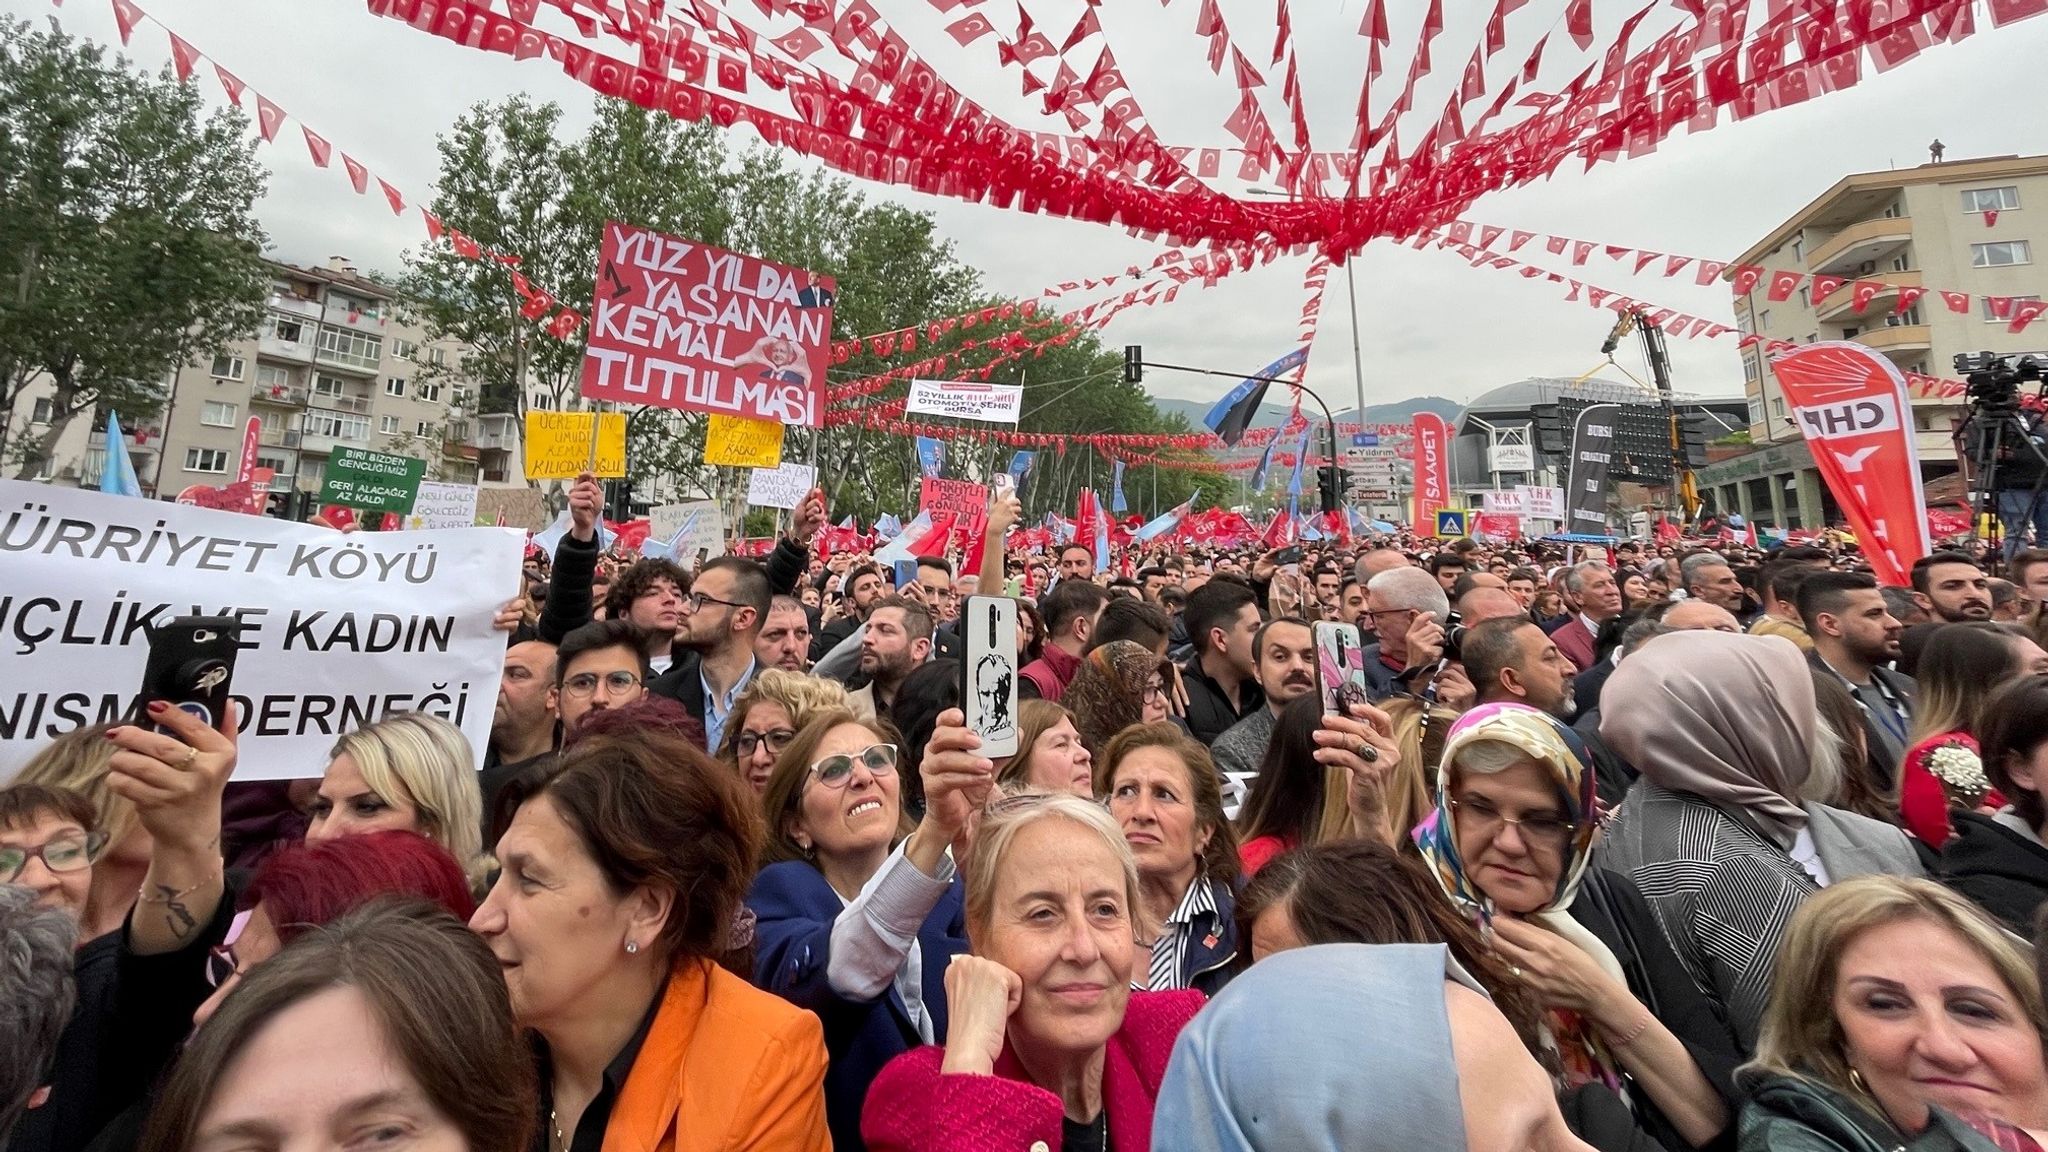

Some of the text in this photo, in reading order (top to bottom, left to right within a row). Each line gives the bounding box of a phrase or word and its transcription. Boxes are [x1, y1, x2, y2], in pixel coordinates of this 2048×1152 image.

[612, 225, 802, 307] YÜZ YILDA
[595, 298, 736, 368] KEMAL
[643, 270, 824, 347] YAŞANAN
[586, 346, 815, 426] TUTULMASI
[1359, 449, 1394, 457] Yıldırım
[1422, 427, 1441, 499] SAADET
[336, 490, 385, 505] AZ KALDI
[930, 479, 984, 498] PARAYLA
[0, 502, 439, 584] ÜRRİYET KÖYÜ
[1195, 520, 1217, 535] CHP
[191, 604, 269, 650] E
[283, 609, 456, 653] KADIN
